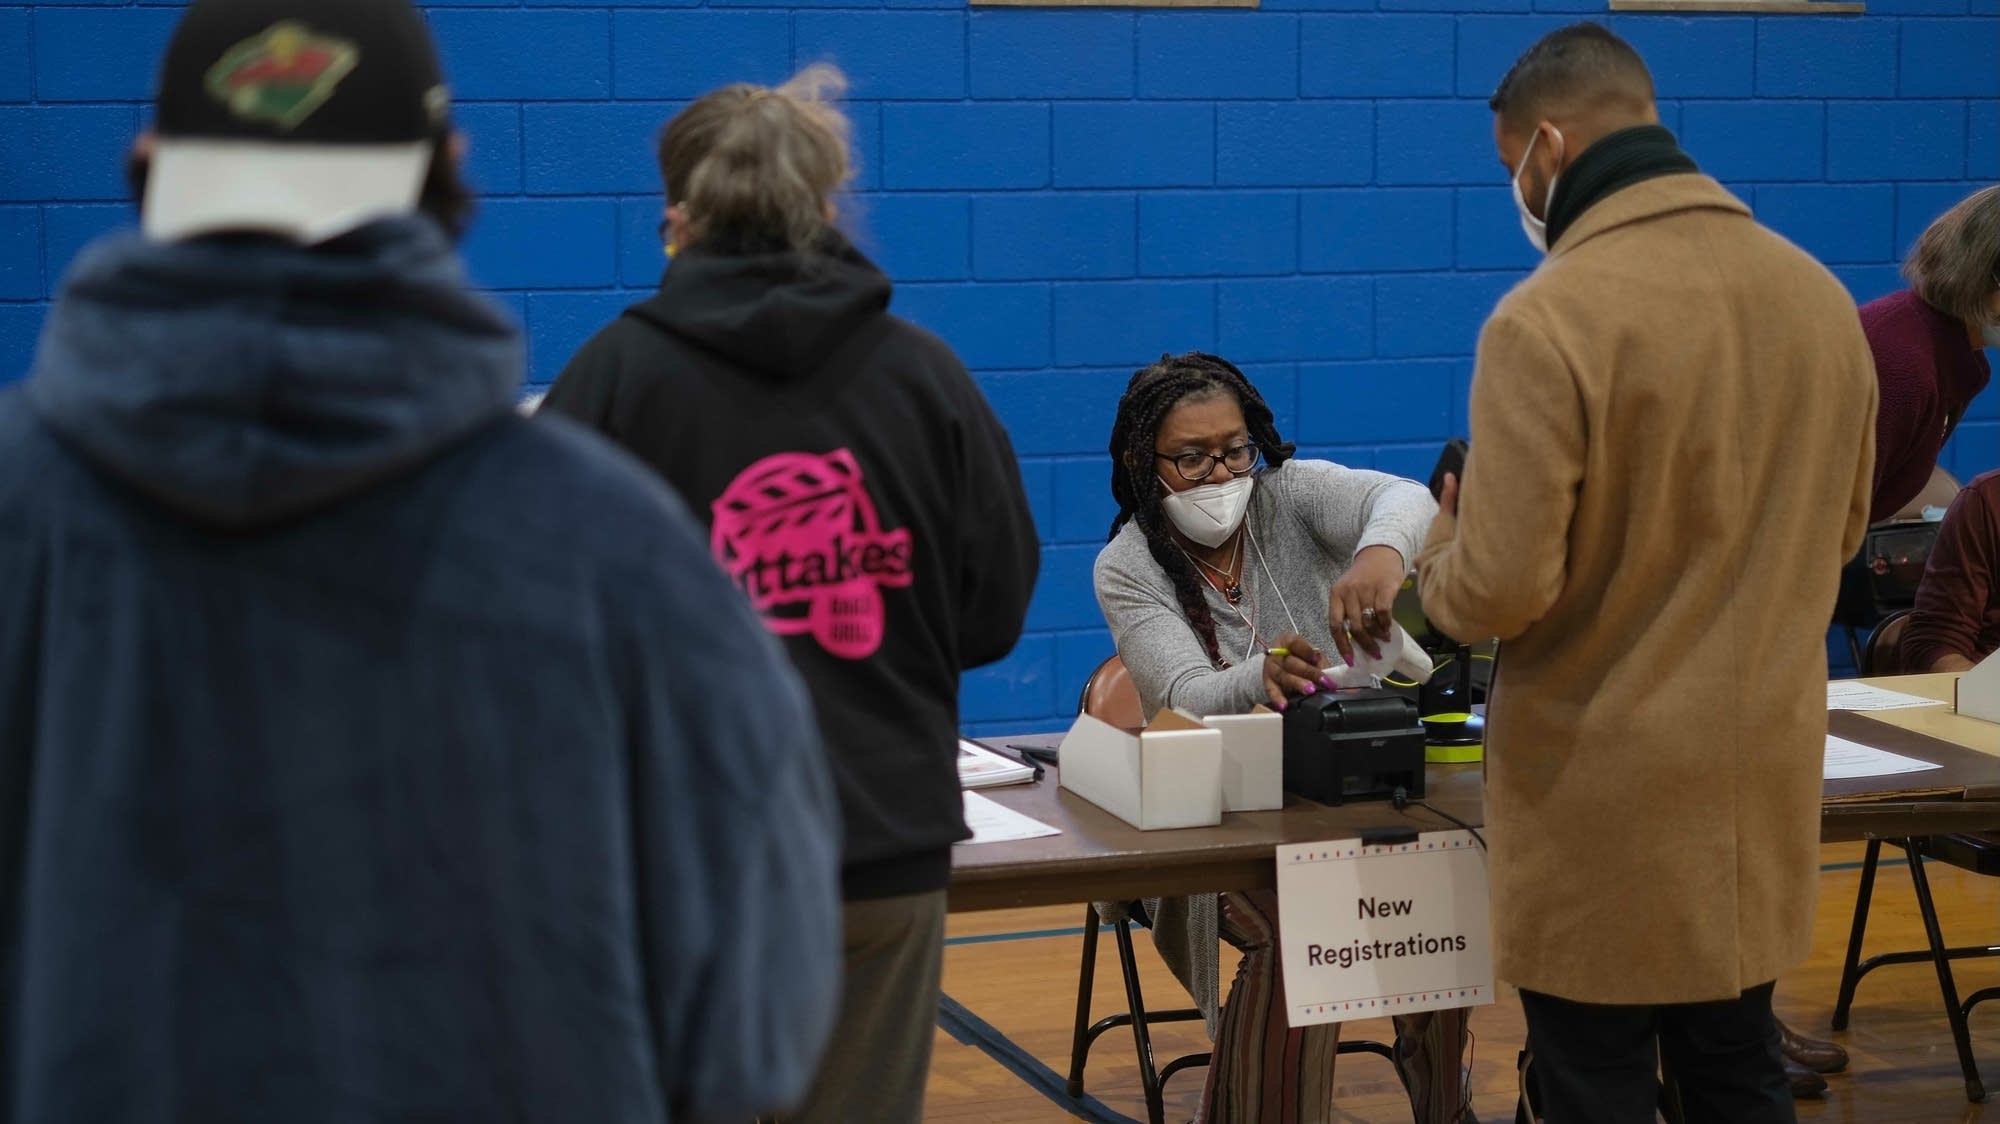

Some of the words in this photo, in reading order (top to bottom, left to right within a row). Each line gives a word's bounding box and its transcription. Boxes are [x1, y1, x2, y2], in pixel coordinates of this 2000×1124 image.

[741, 534, 909, 596] ttakes
[1358, 897, 1413, 920] New
[1308, 933, 1467, 969] Registrations
